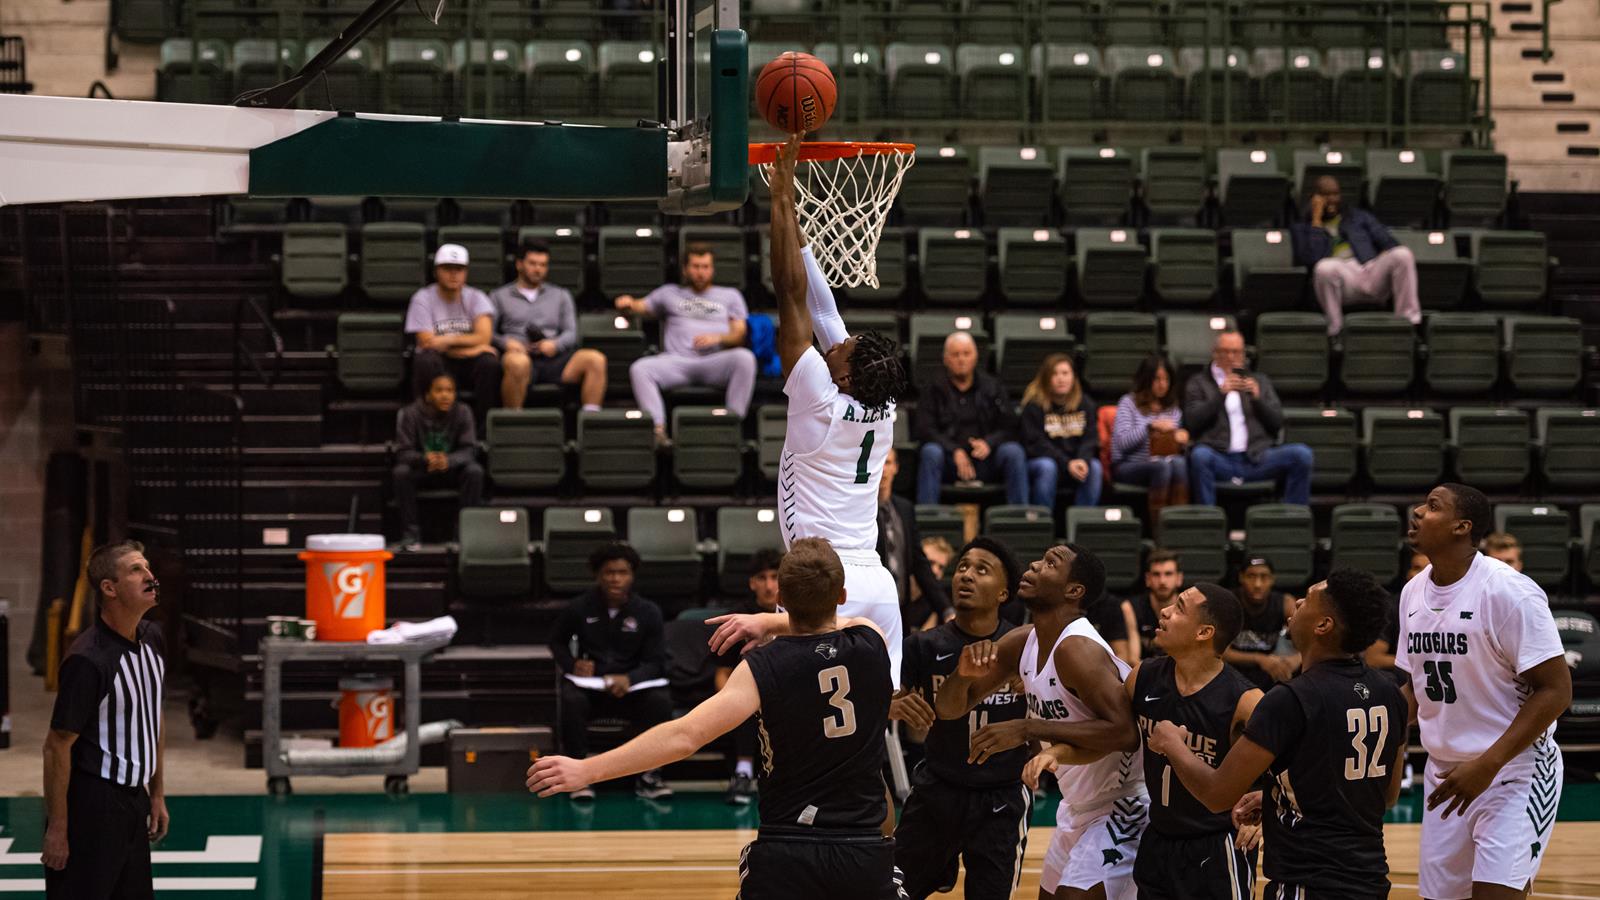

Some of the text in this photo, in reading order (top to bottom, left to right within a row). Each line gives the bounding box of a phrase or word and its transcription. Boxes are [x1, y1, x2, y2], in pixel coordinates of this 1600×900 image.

[854, 429, 875, 484] 1
[337, 567, 362, 594] G
[1407, 632, 1468, 655] COUGARS
[818, 665, 856, 738] 3
[1423, 660, 1457, 704] 35
[370, 697, 388, 718] G
[1139, 714, 1217, 757] PUUE
[1345, 705, 1389, 781] 32
[1161, 764, 1171, 807] 1
